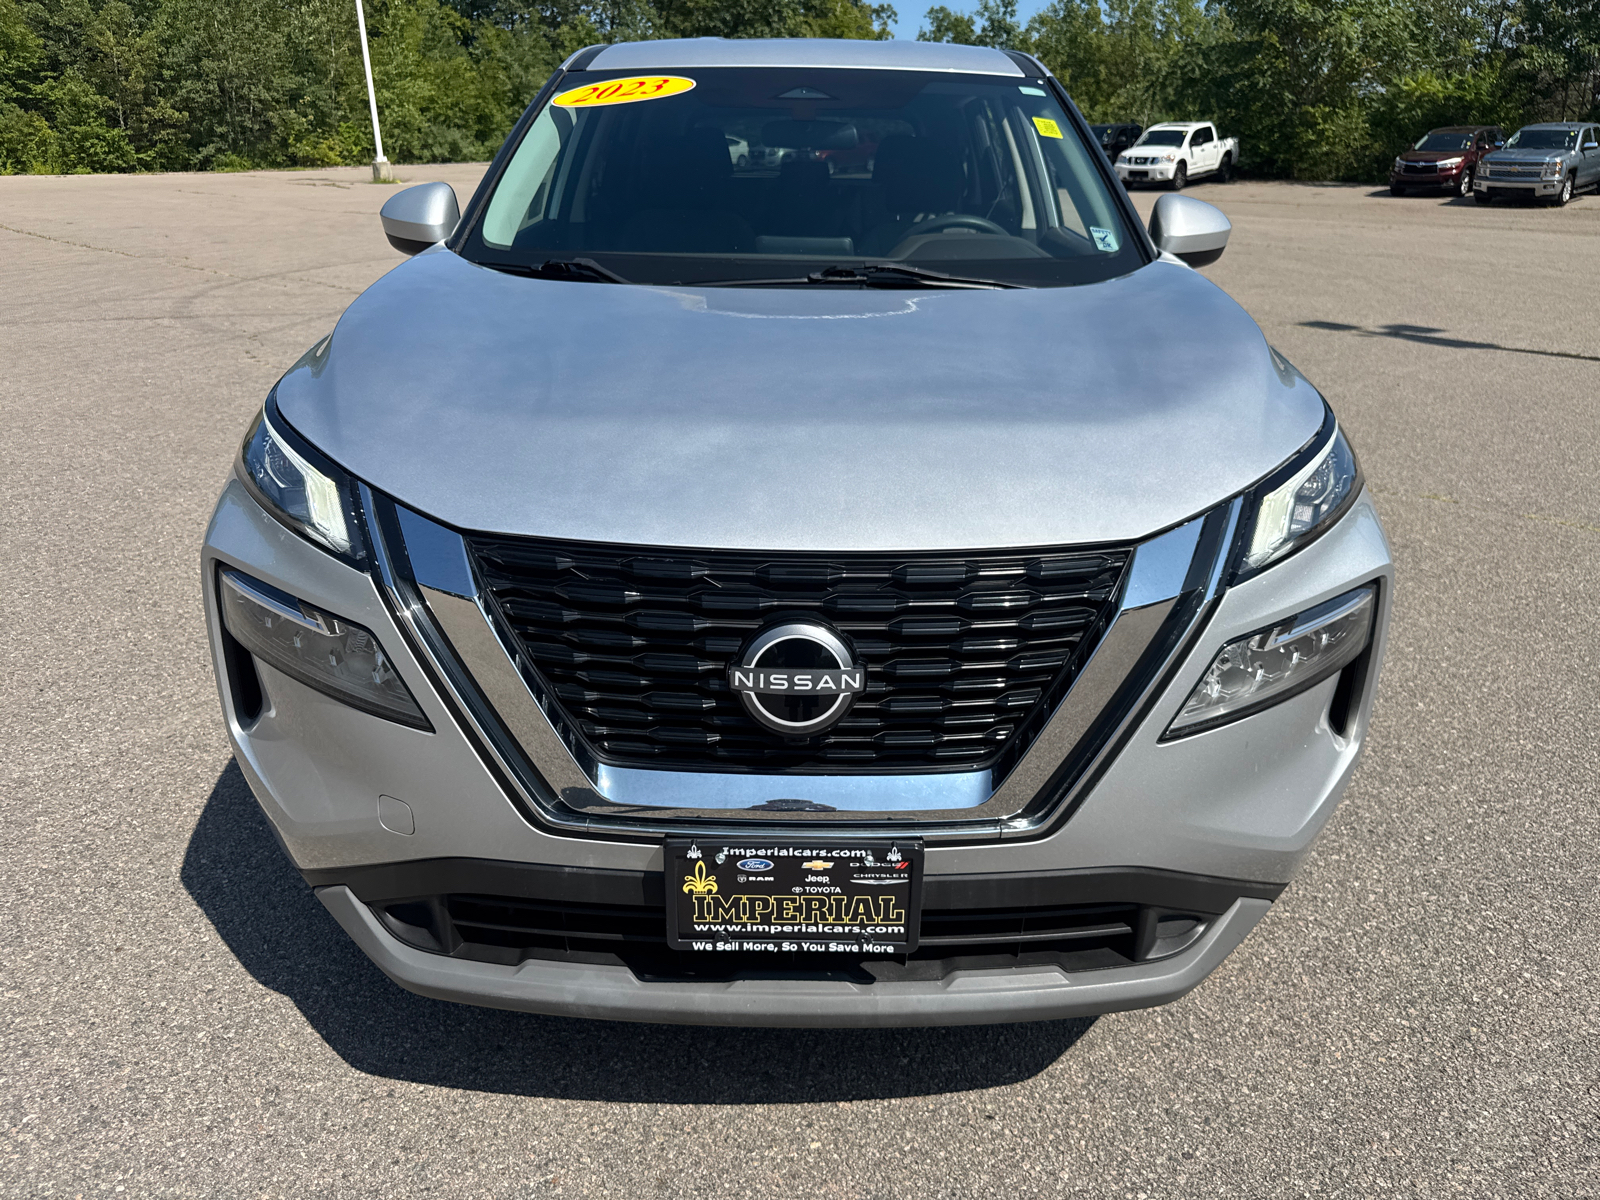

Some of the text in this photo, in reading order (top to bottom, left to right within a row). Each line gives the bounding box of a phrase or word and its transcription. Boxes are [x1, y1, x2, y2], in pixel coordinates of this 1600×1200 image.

[570, 79, 669, 104] 2023
[734, 670, 860, 690] NISSAN
[722, 847, 867, 858] Imperialcars.com
[805, 874, 830, 884] Jeep
[805, 886, 842, 894] TOYOTA
[693, 895, 905, 924] IMPERIAL
[694, 923, 905, 934] www.imperialcars.com
[692, 941, 894, 953] We Sell More, So You Save More
